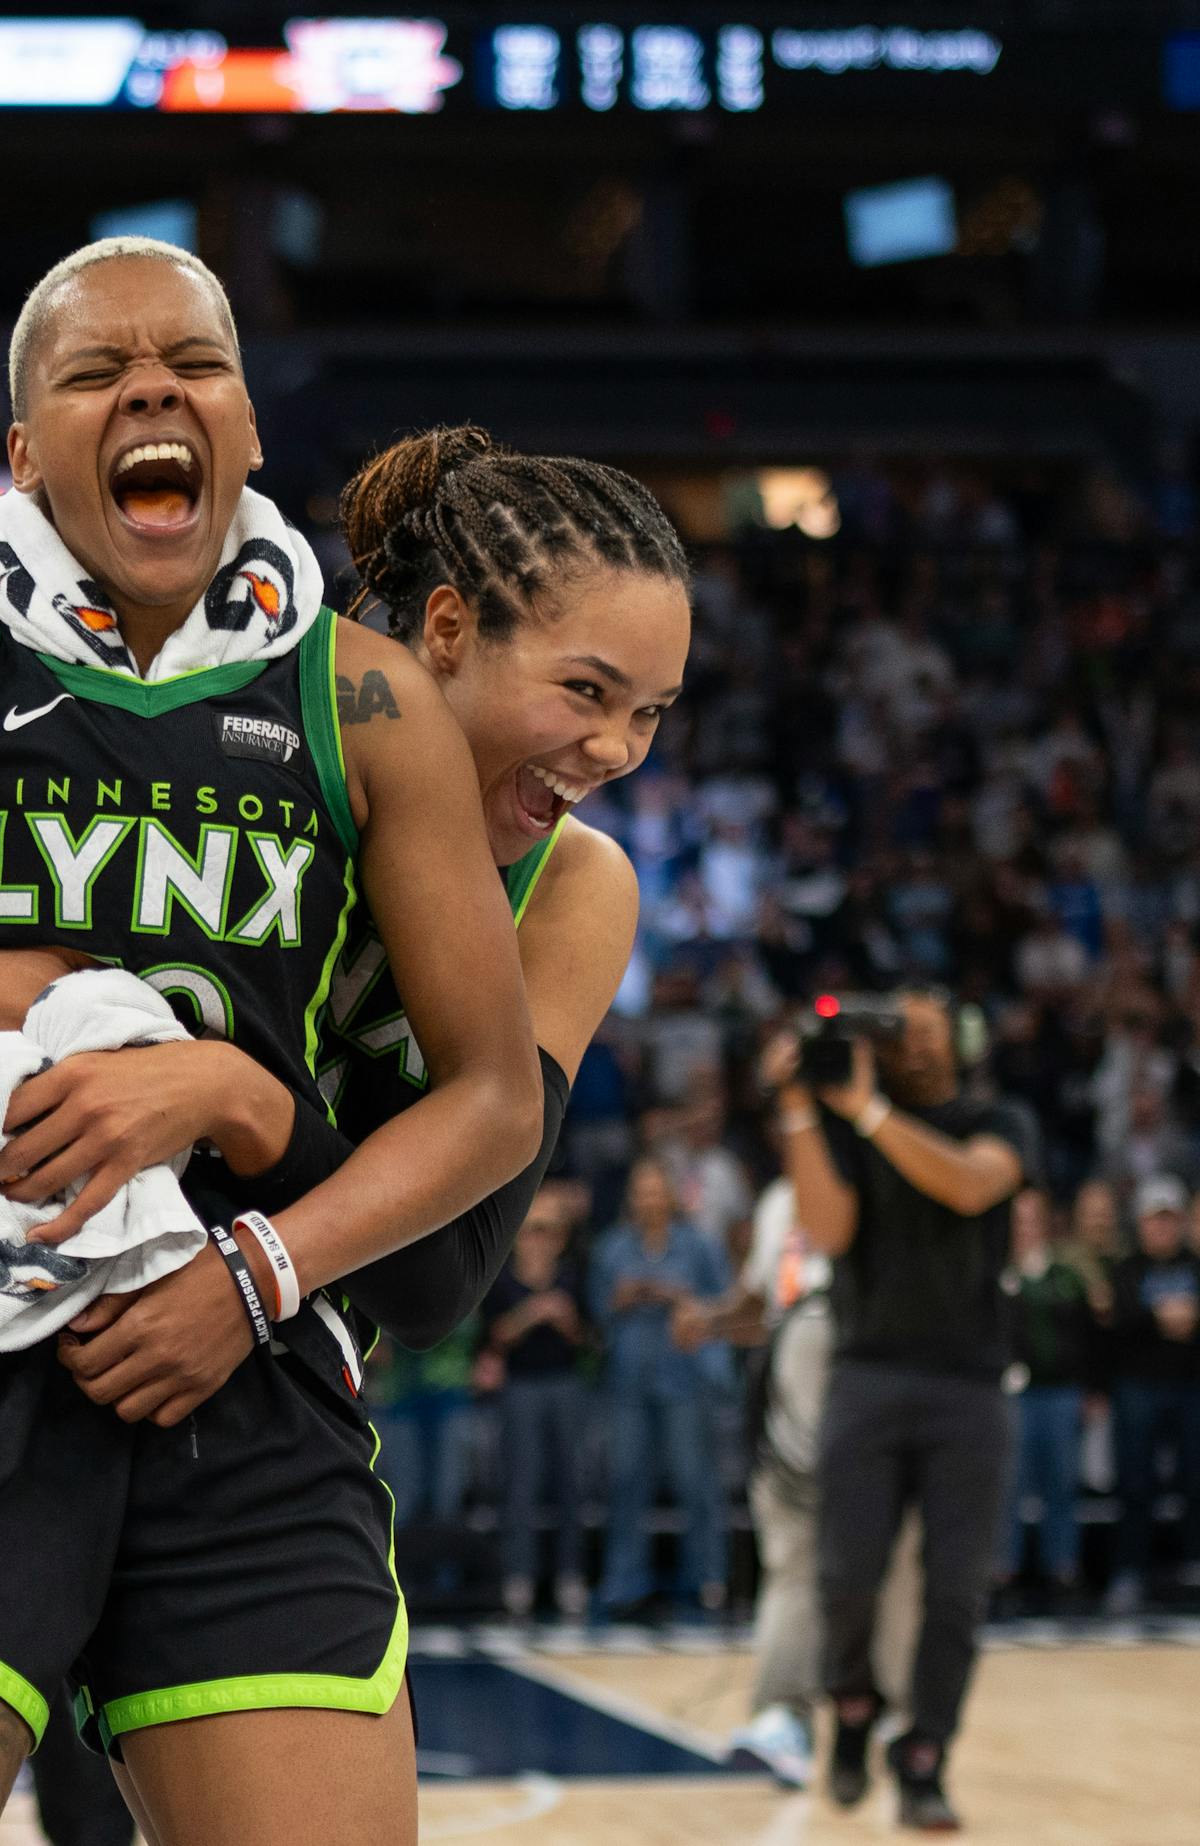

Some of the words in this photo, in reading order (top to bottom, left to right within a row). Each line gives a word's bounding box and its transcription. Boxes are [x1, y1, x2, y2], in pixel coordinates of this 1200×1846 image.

[221, 730, 282, 754] INSURANCE
[223, 715, 300, 750] FEDERATED
[274, 1253, 289, 1271] BE
[236, 1269, 263, 1316] PERSON
